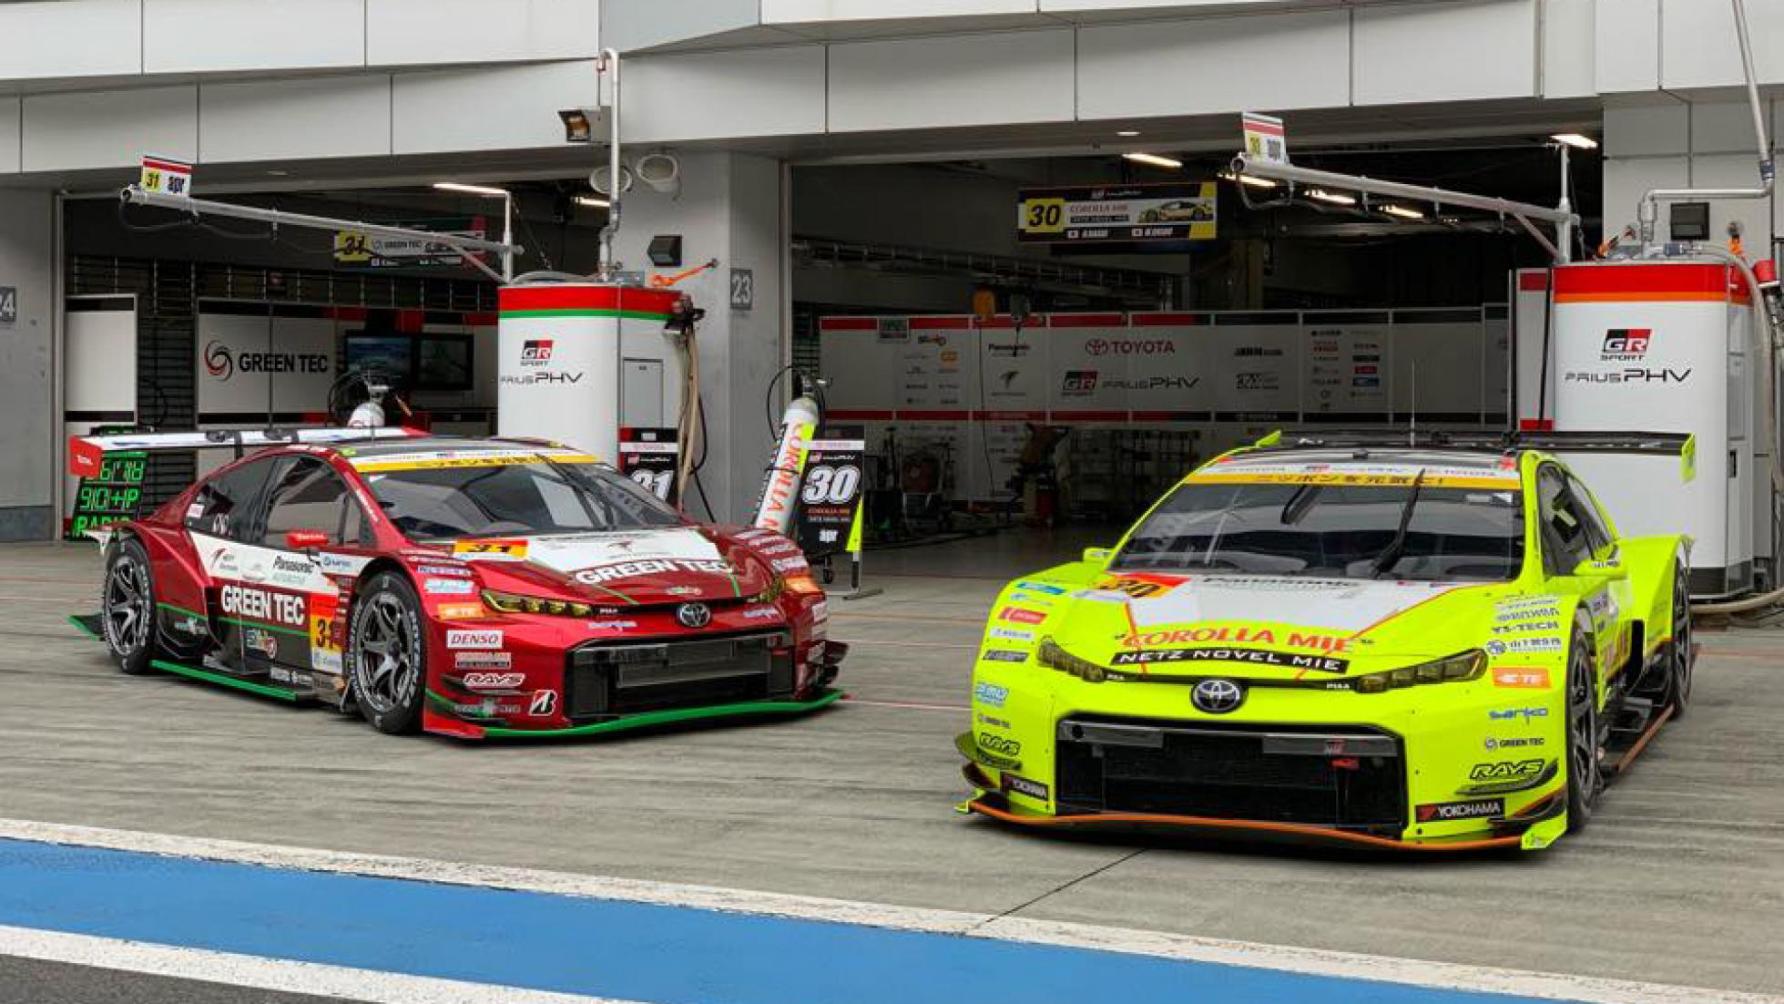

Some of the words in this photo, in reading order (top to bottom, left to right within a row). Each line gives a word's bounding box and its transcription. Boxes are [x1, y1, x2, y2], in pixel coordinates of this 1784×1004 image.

[1029, 203, 1061, 227] 30
[731, 273, 752, 304] 23
[1111, 340, 1176, 354] TOYOTA
[239, 353, 295, 373] GREEN
[298, 354, 328, 373] TEC
[801, 465, 861, 504] 30
[273, 555, 315, 574] Panasonic
[576, 558, 680, 585] GREEN
[221, 585, 272, 621] GREEN
[274, 592, 305, 626] TEC
[451, 633, 499, 644] DENSO
[1122, 627, 1275, 646] COROLLA
[1287, 631, 1353, 653] MIE
[1119, 650, 1185, 663] NETZ
[1192, 650, 1281, 664] NOVEL
[1292, 656, 1341, 671] MIE
[463, 673, 526, 689] RAYS
[1500, 739, 1528, 748] GREEN
[1529, 738, 1545, 746] TEC
[1469, 758, 1545, 780] RAYS
[1437, 802, 1500, 818] YOKOHAMA
